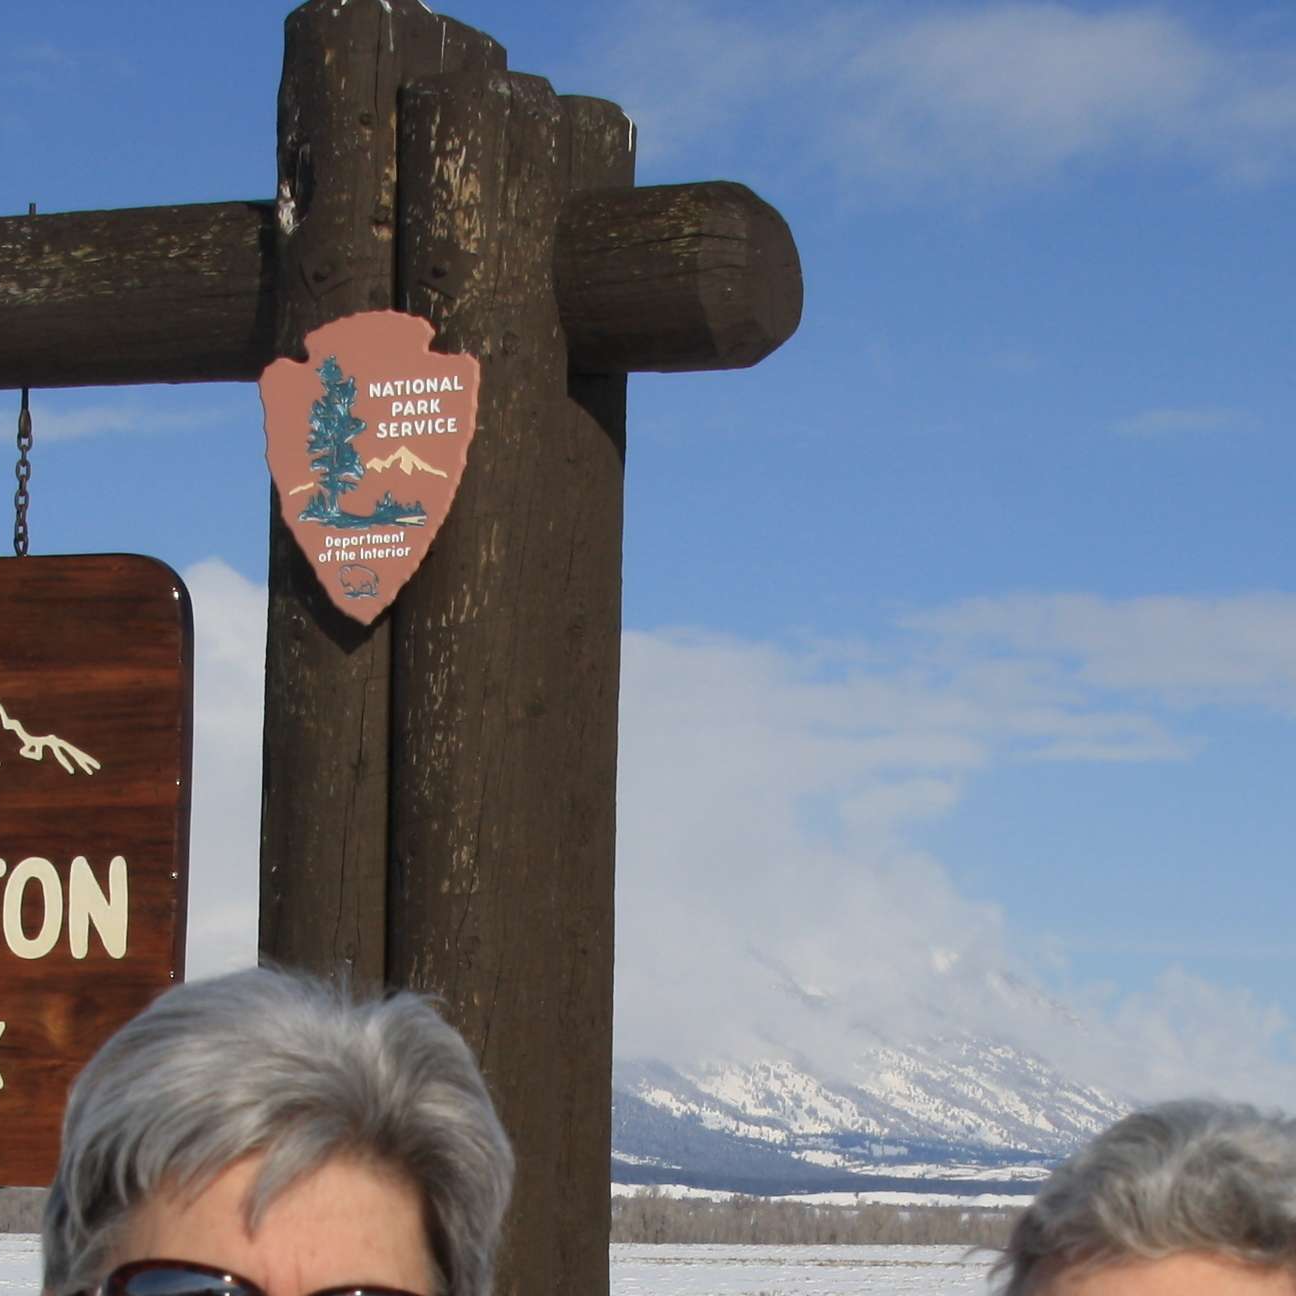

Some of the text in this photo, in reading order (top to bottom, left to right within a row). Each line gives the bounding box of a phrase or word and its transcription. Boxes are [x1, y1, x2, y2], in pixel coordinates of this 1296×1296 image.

[368, 375, 464, 398] NATIONAL
[391, 398, 441, 417] PARK
[376, 417, 458, 439] SERVICE
[325, 531, 404, 549] Department
[318, 545, 411, 562] of the Interior
